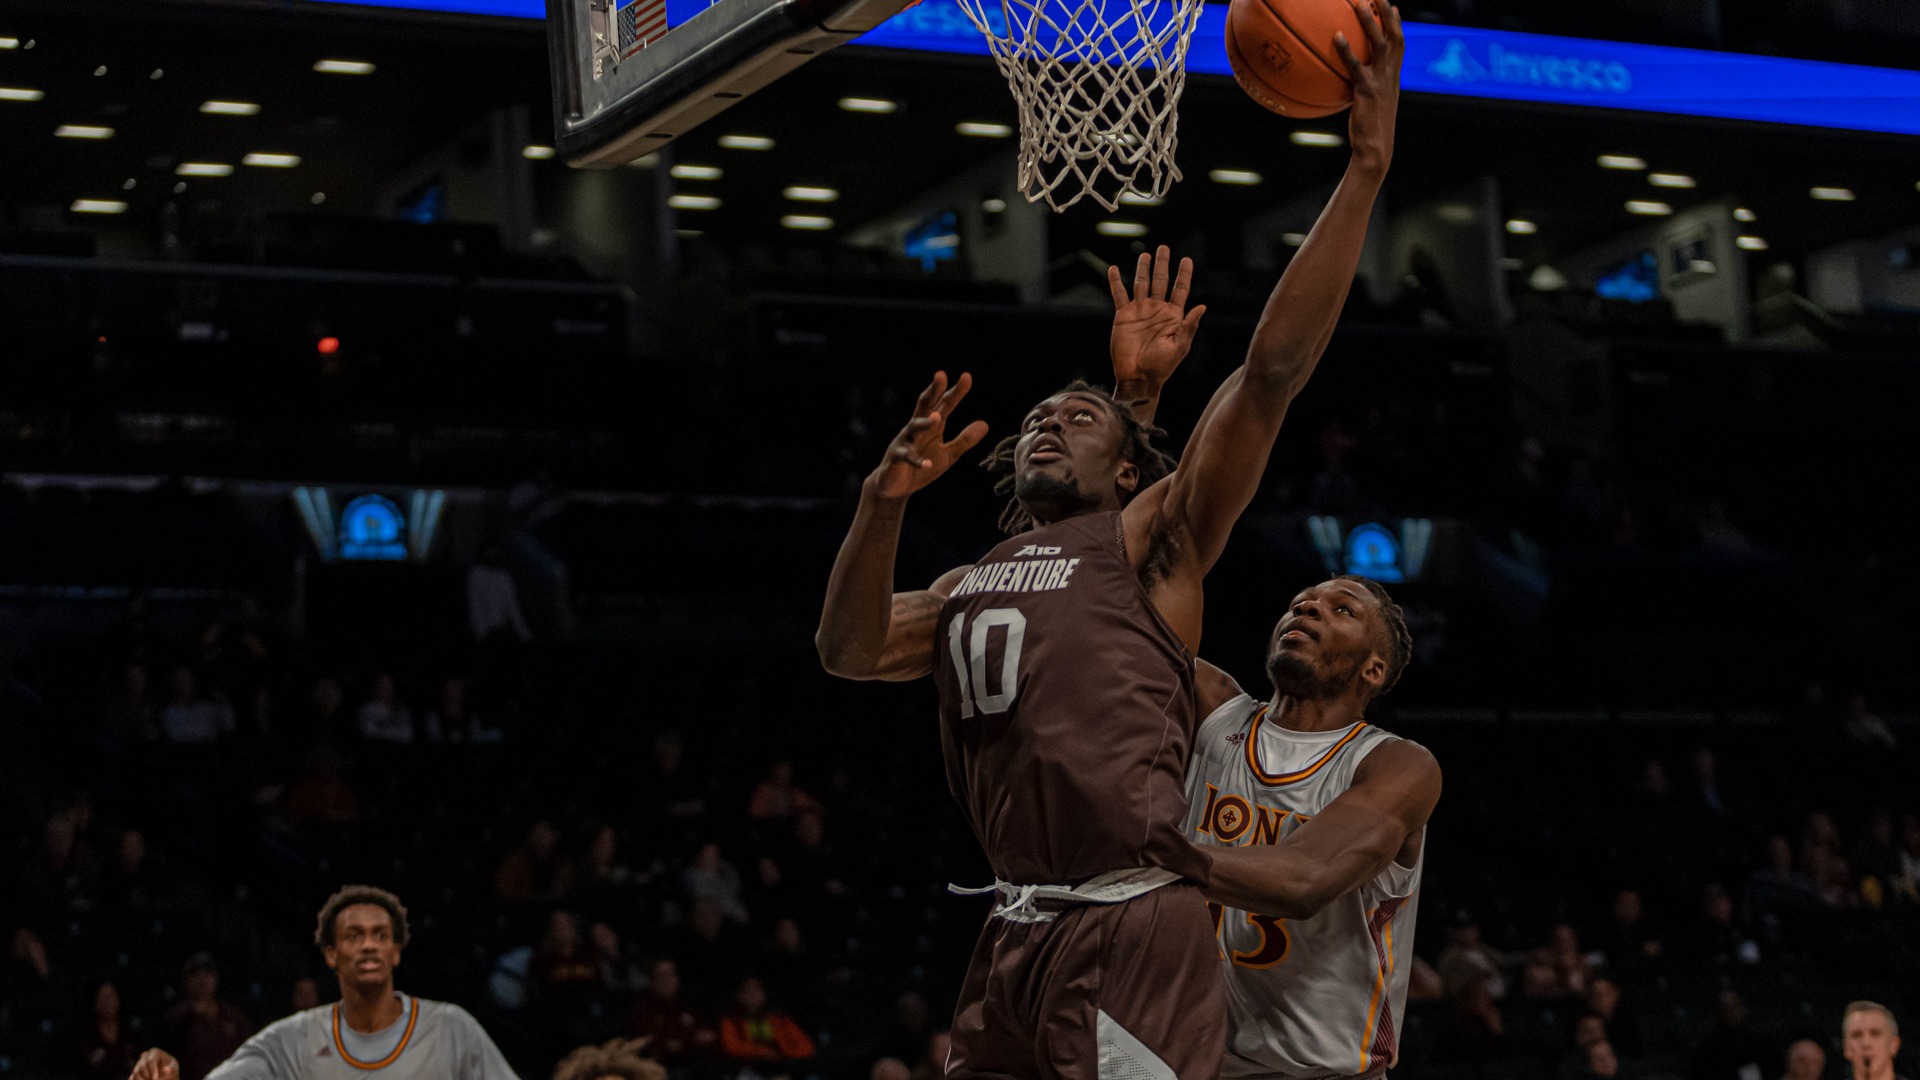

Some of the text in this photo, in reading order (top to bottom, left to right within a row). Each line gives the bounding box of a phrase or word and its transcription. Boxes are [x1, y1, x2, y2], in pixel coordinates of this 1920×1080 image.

[1489, 42, 1632, 93] Invesco
[1013, 544, 1062, 557] A10
[948, 607, 1027, 720] 10
[1196, 781, 1312, 846] ION
